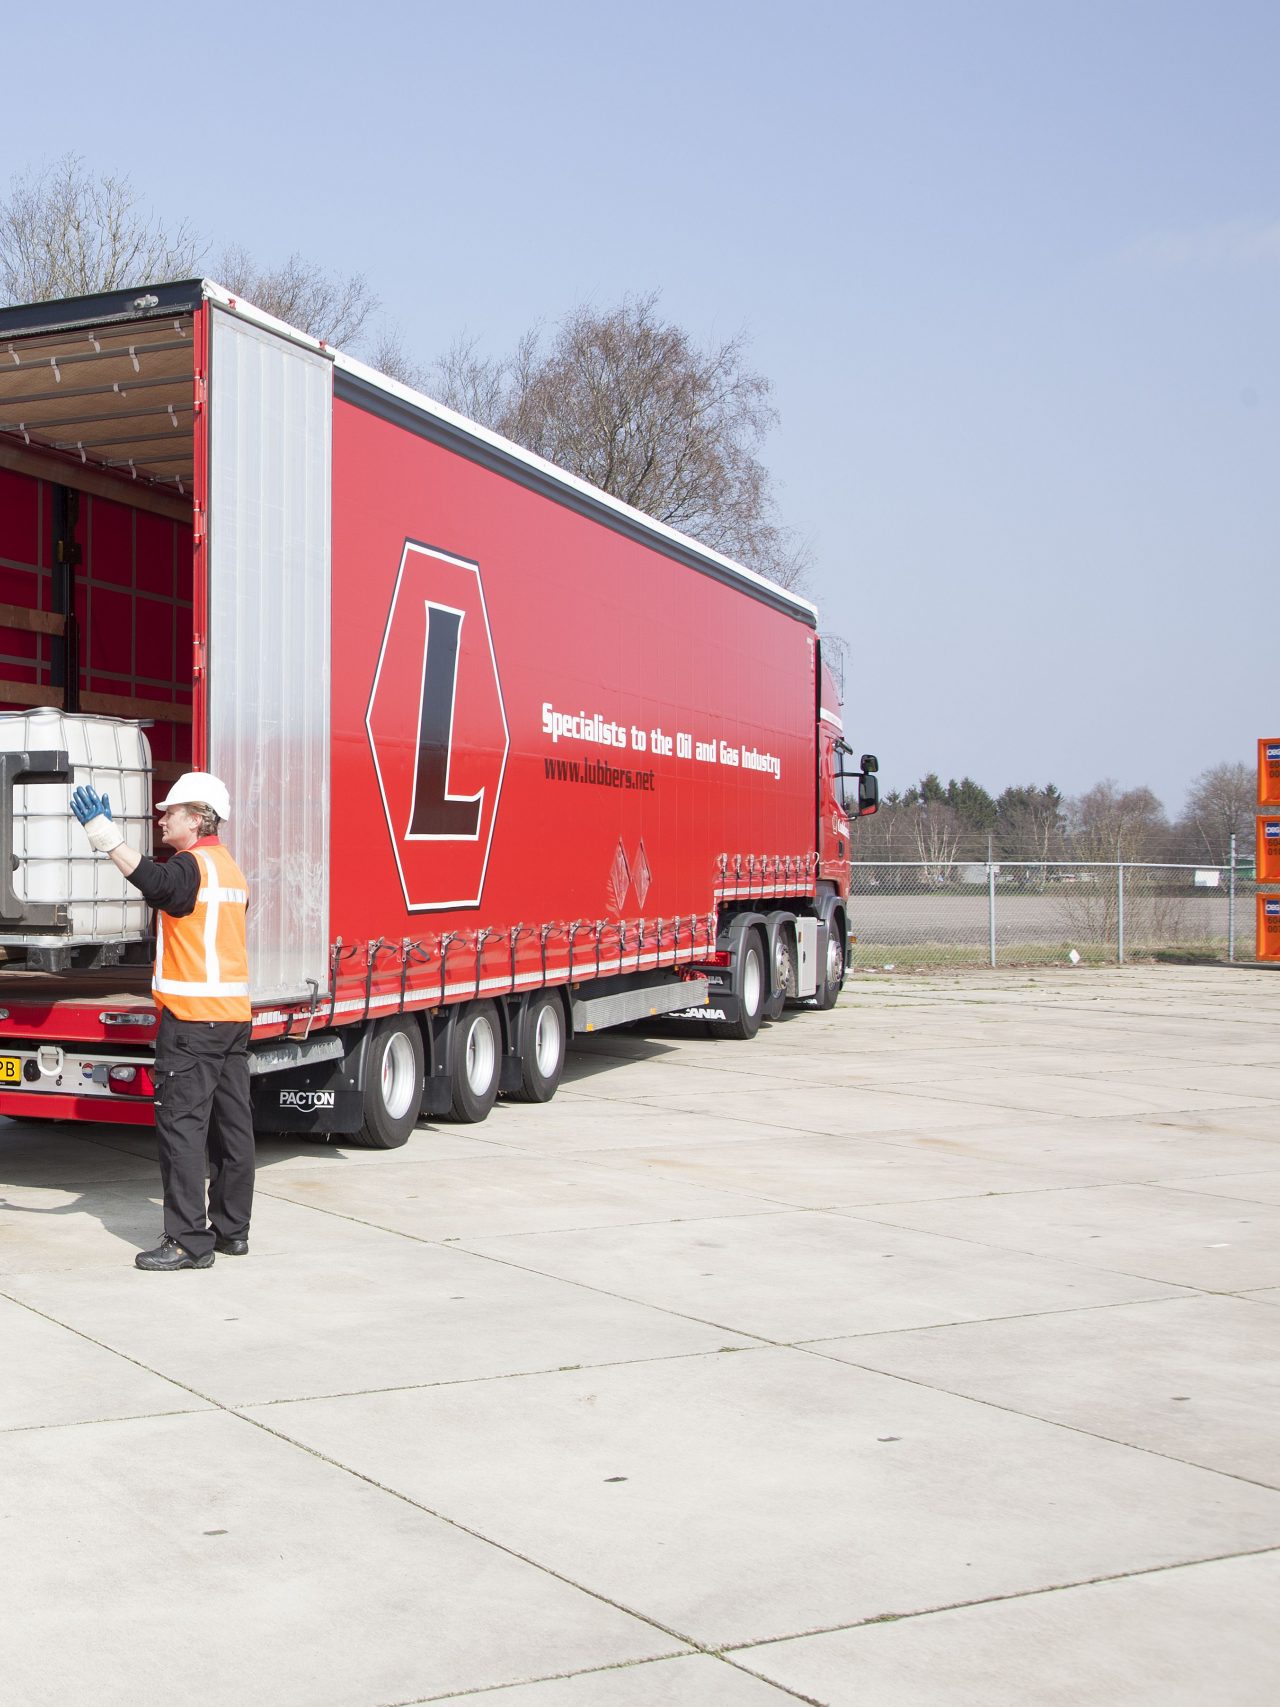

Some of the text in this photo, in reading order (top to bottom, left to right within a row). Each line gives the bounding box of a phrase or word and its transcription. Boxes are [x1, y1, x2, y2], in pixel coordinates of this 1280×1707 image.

[404, 600, 485, 841] L
[542, 702, 780, 779] Specialists to the Oil and Gas Industry
[544, 757, 655, 791] www.lubbers.net
[1267, 839, 1280, 847] 60
[280, 1091, 335, 1105] PACTON
